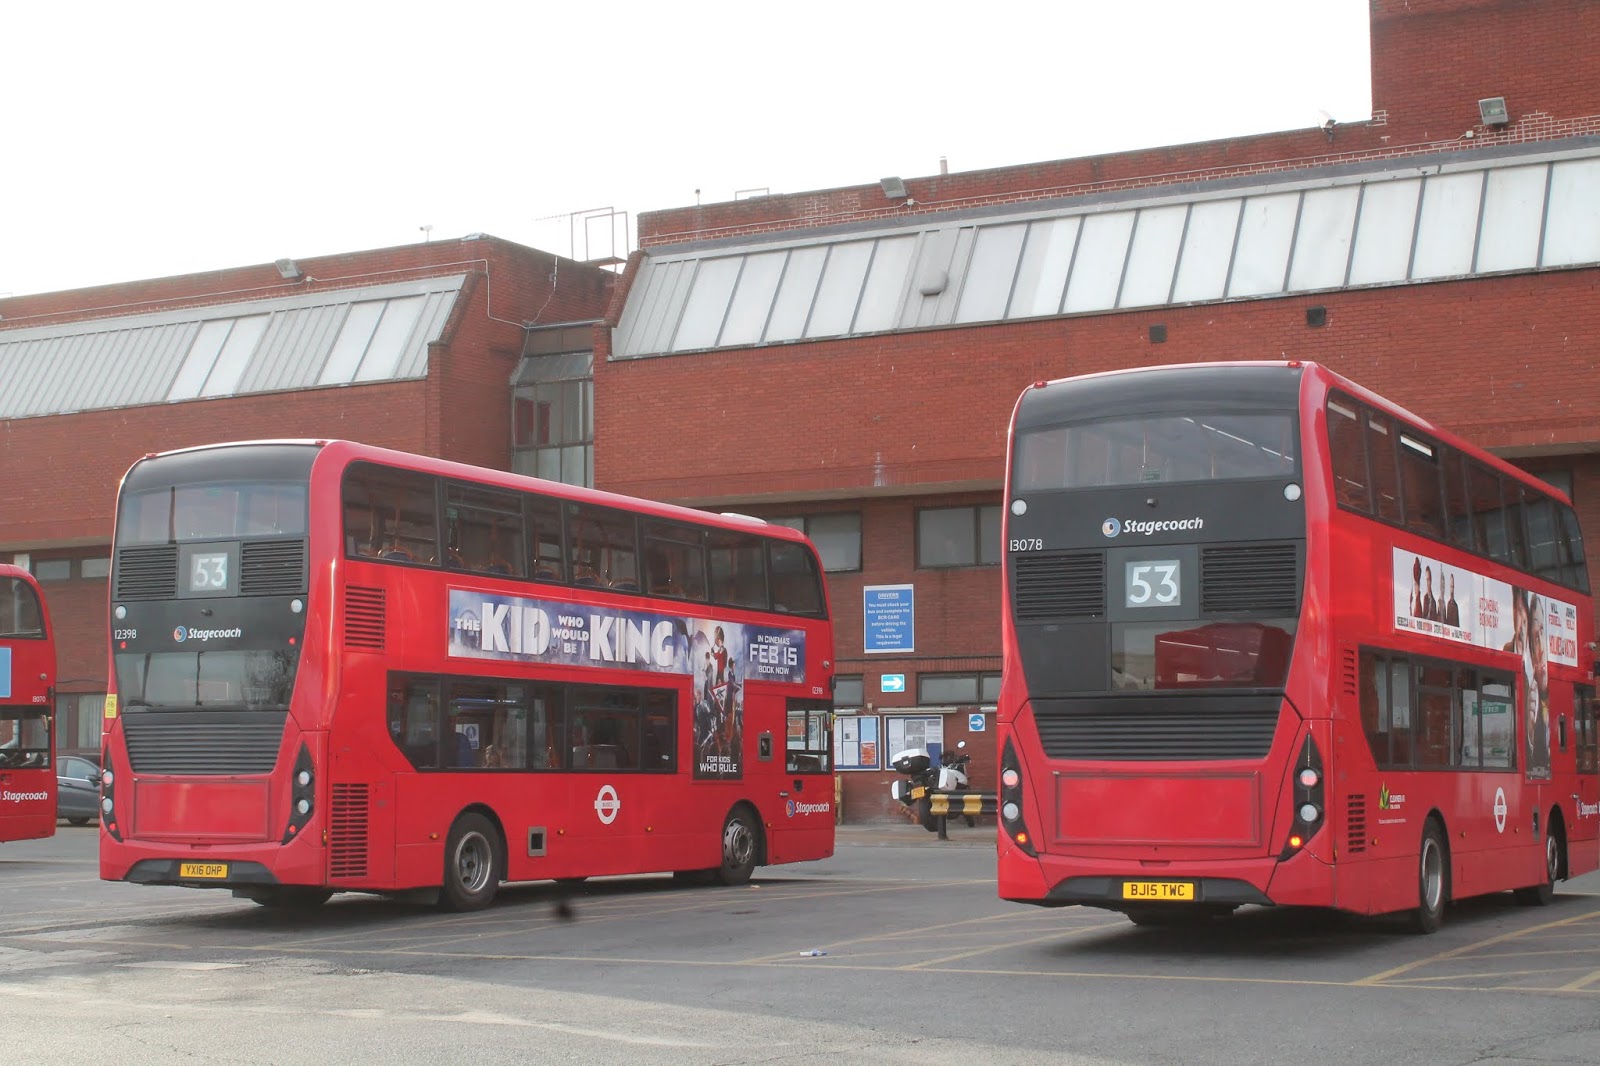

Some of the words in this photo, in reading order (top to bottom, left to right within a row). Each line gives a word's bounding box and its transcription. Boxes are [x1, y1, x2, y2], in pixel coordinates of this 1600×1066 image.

[1123, 517, 1203, 536] Stagecoach
[1009, 538, 1043, 551] 13078
[194, 557, 227, 588] 53
[1129, 565, 1178, 604] 53
[455, 617, 480, 632] THE
[481, 602, 550, 655] KID
[558, 615, 584, 629] WHO
[114, 628, 137, 640] 12398
[188, 627, 241, 642] Stagecoach
[552, 628, 590, 641] WOULD
[590, 614, 674, 667] KING
[757, 635, 764, 643] IN
[764, 635, 791, 646] CINEMAS
[563, 643, 577, 654] BE
[750, 643, 779, 664] FEB
[783, 646, 798, 666] 15
[758, 665, 775, 674] BOOK
[776, 666, 790, 675] NOW
[706, 755, 717, 763] FOR
[718, 755, 731, 763] KIDS
[700, 762, 717, 773] WHO
[719, 763, 737, 773] RULE
[2, 790, 48, 803] Stagecoach
[795, 801, 830, 816] Stagecoach
[186, 864, 204, 876] YX16
[205, 865, 222, 876] OHP
[1130, 884, 1158, 896] BJ15
[1161, 884, 1185, 896] TWC
